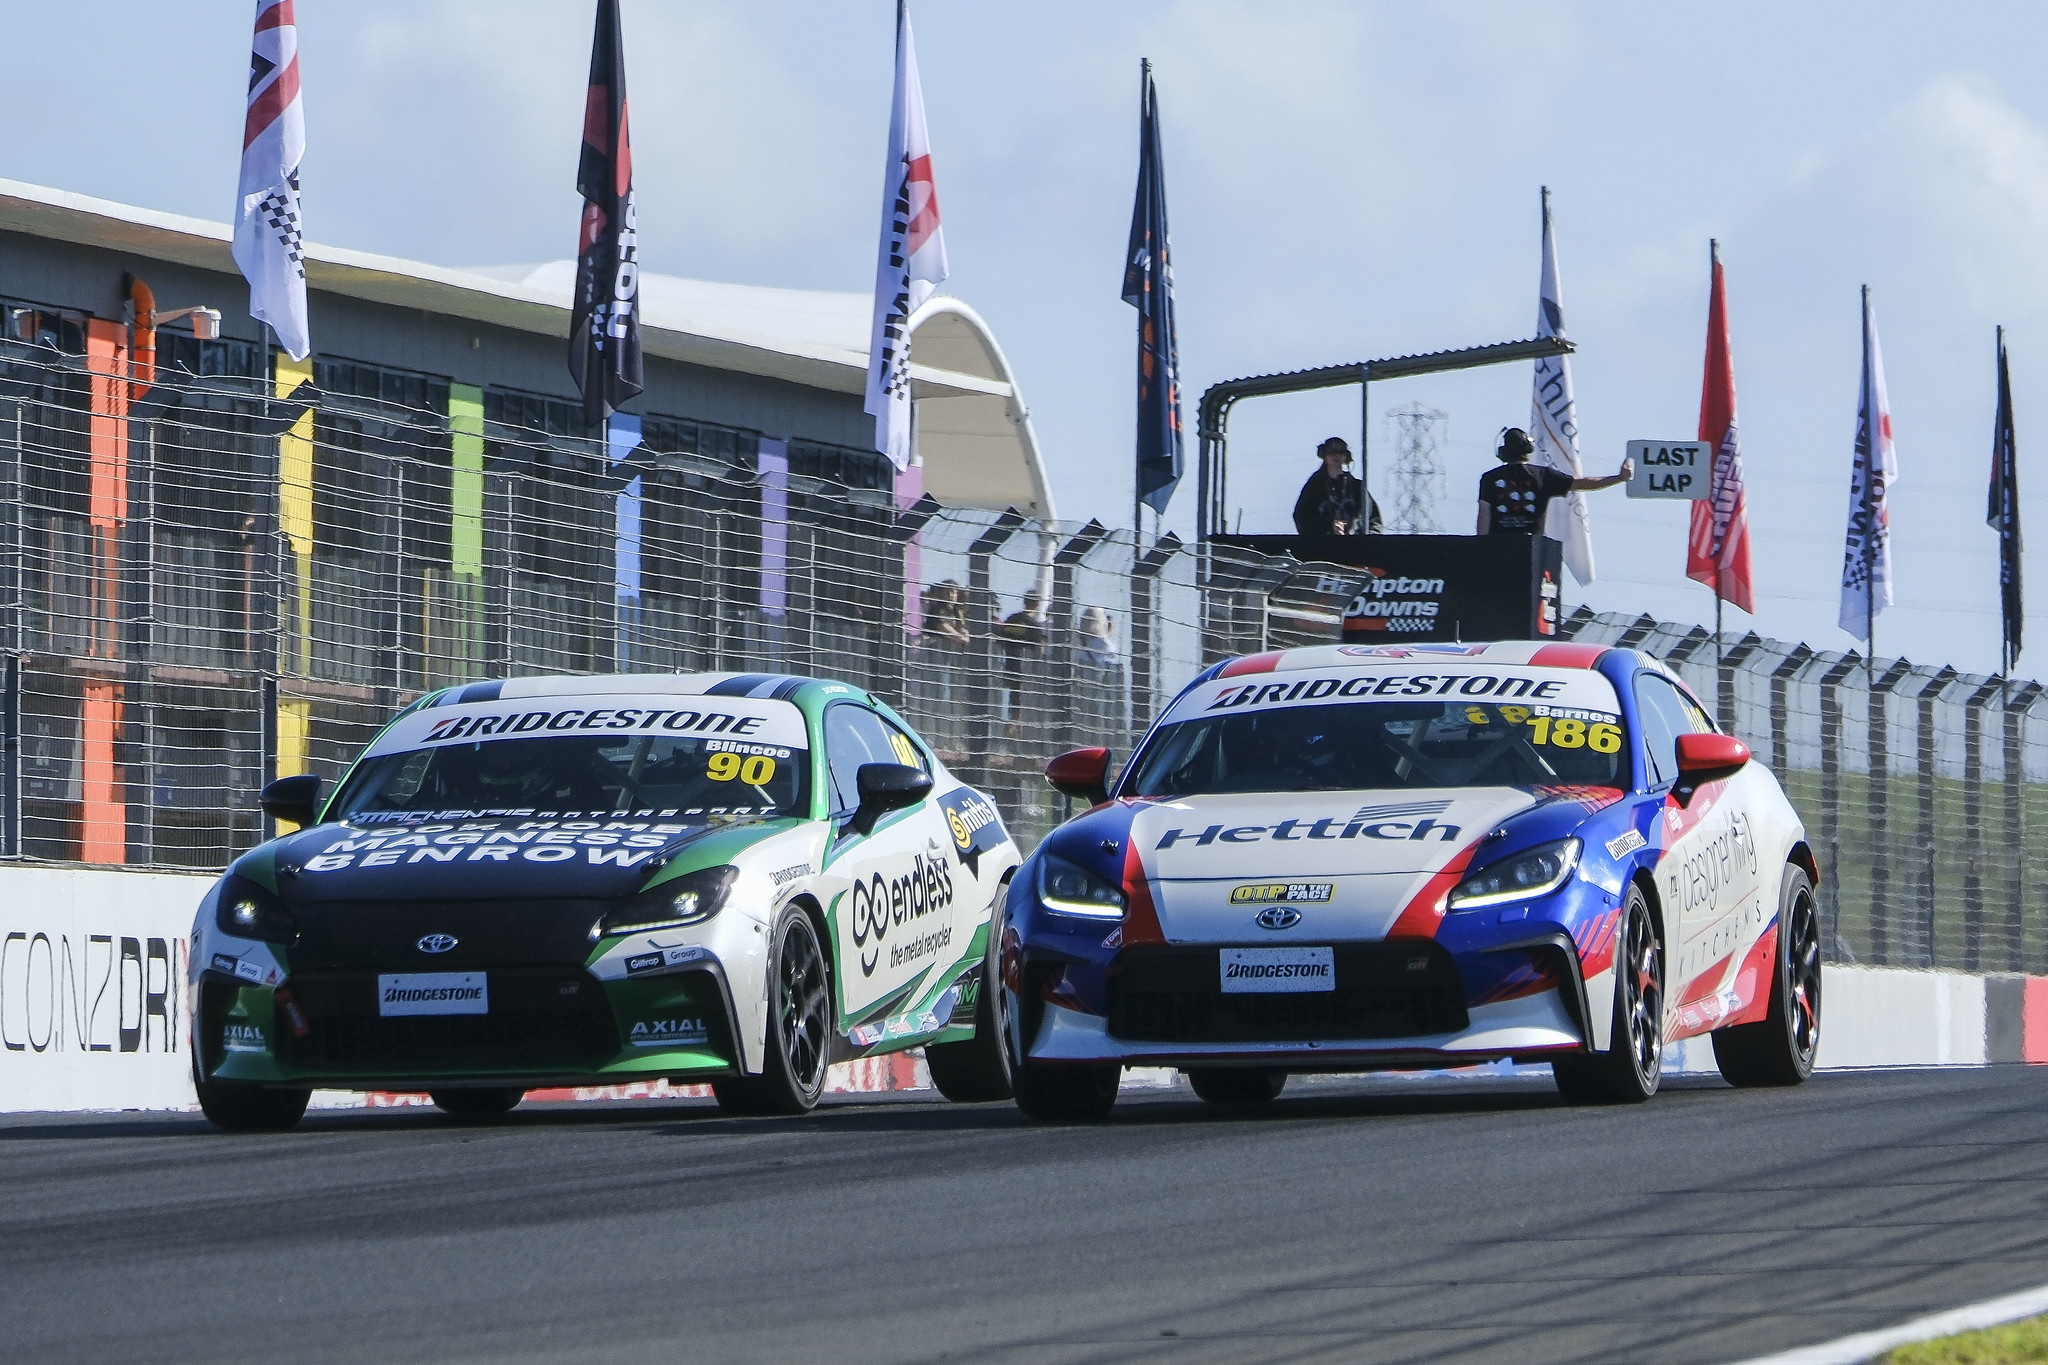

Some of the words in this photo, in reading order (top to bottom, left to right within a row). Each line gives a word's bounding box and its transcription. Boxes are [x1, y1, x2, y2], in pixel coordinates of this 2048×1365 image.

[1643, 447, 1699, 467] LAST
[1650, 474, 1692, 493] LAP
[1345, 596, 1440, 616] Downs
[1205, 675, 1568, 711] BRIDGESTONE
[1534, 706, 1617, 724] Barnes
[420, 709, 768, 743] BRIDGESTONE
[1526, 718, 1622, 754] 186
[705, 740, 790, 758] Blincoe
[705, 752, 776, 786] 90
[517, 821, 688, 835] HOME
[1155, 818, 1462, 850] Hettich
[322, 831, 671, 854] MAGNESS
[303, 846, 657, 872] BENROW
[891, 854, 953, 927] endless
[1234, 885, 1288, 900] OTP
[1286, 890, 1331, 900] PACE
[889, 943, 904, 969] the
[903, 931, 925, 964] metal
[924, 922, 952, 957] recycler
[1105, 930, 1120, 946] TOW
[670, 948, 697, 960] Group
[1225, 963, 1329, 978] BRIDGESTONE
[384, 987, 483, 1002] BRIDGESTONE
[631, 1018, 707, 1034] AXIAL
